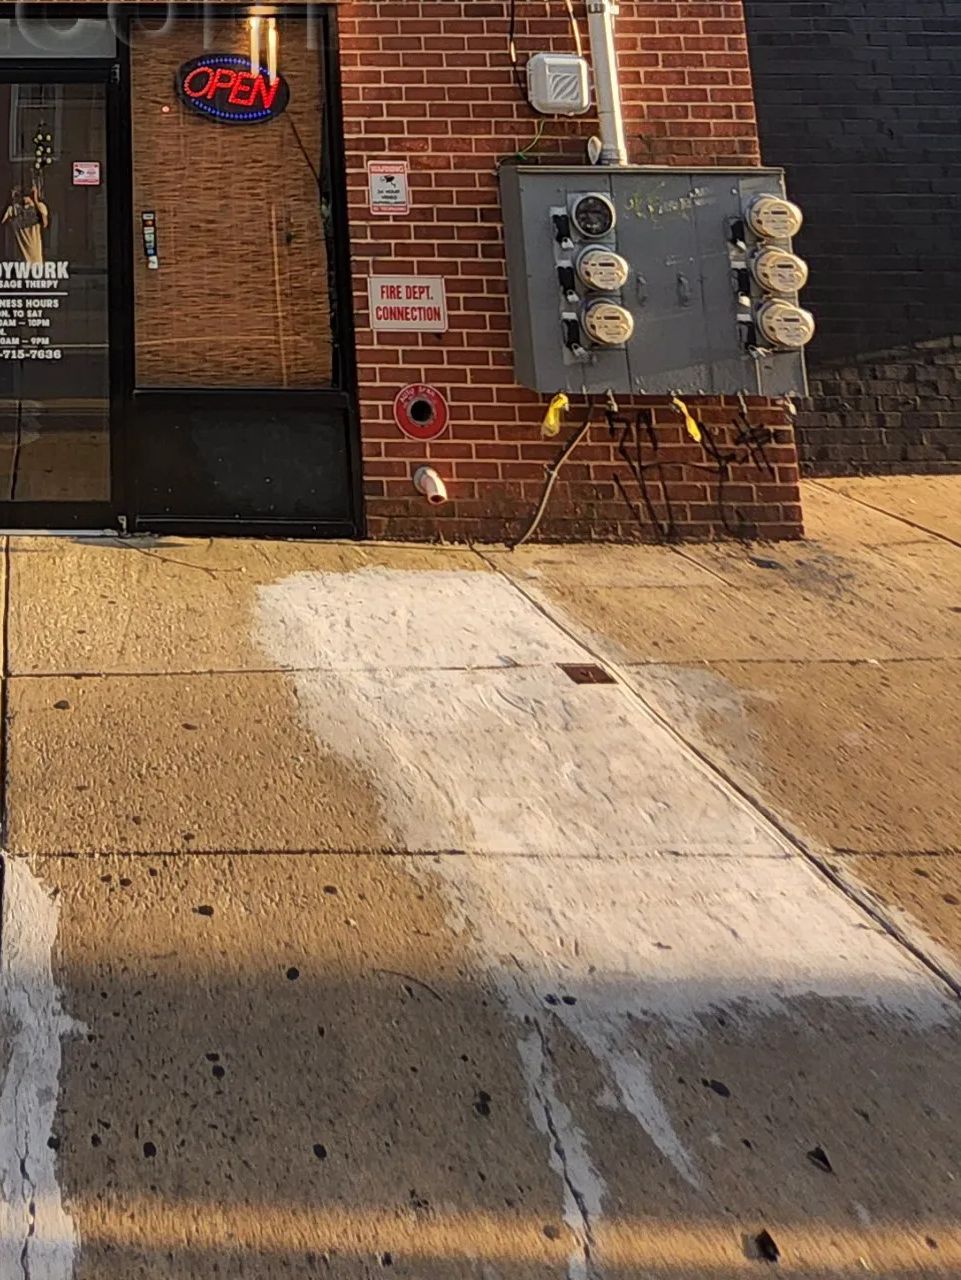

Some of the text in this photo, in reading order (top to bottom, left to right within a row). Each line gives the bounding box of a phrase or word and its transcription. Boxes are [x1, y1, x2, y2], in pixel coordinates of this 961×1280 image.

[183, 66, 280, 109] OPEN
[380, 284, 434, 300] FIRE DEPT.
[26, 299, 59, 308] HOURS
[13, 310, 24, 318] TO
[26, 310, 43, 318] SAT
[375, 306, 441, 322] CONNECTION
[28, 319, 50, 327] 10PM
[30, 337, 49, 345] 9PM
